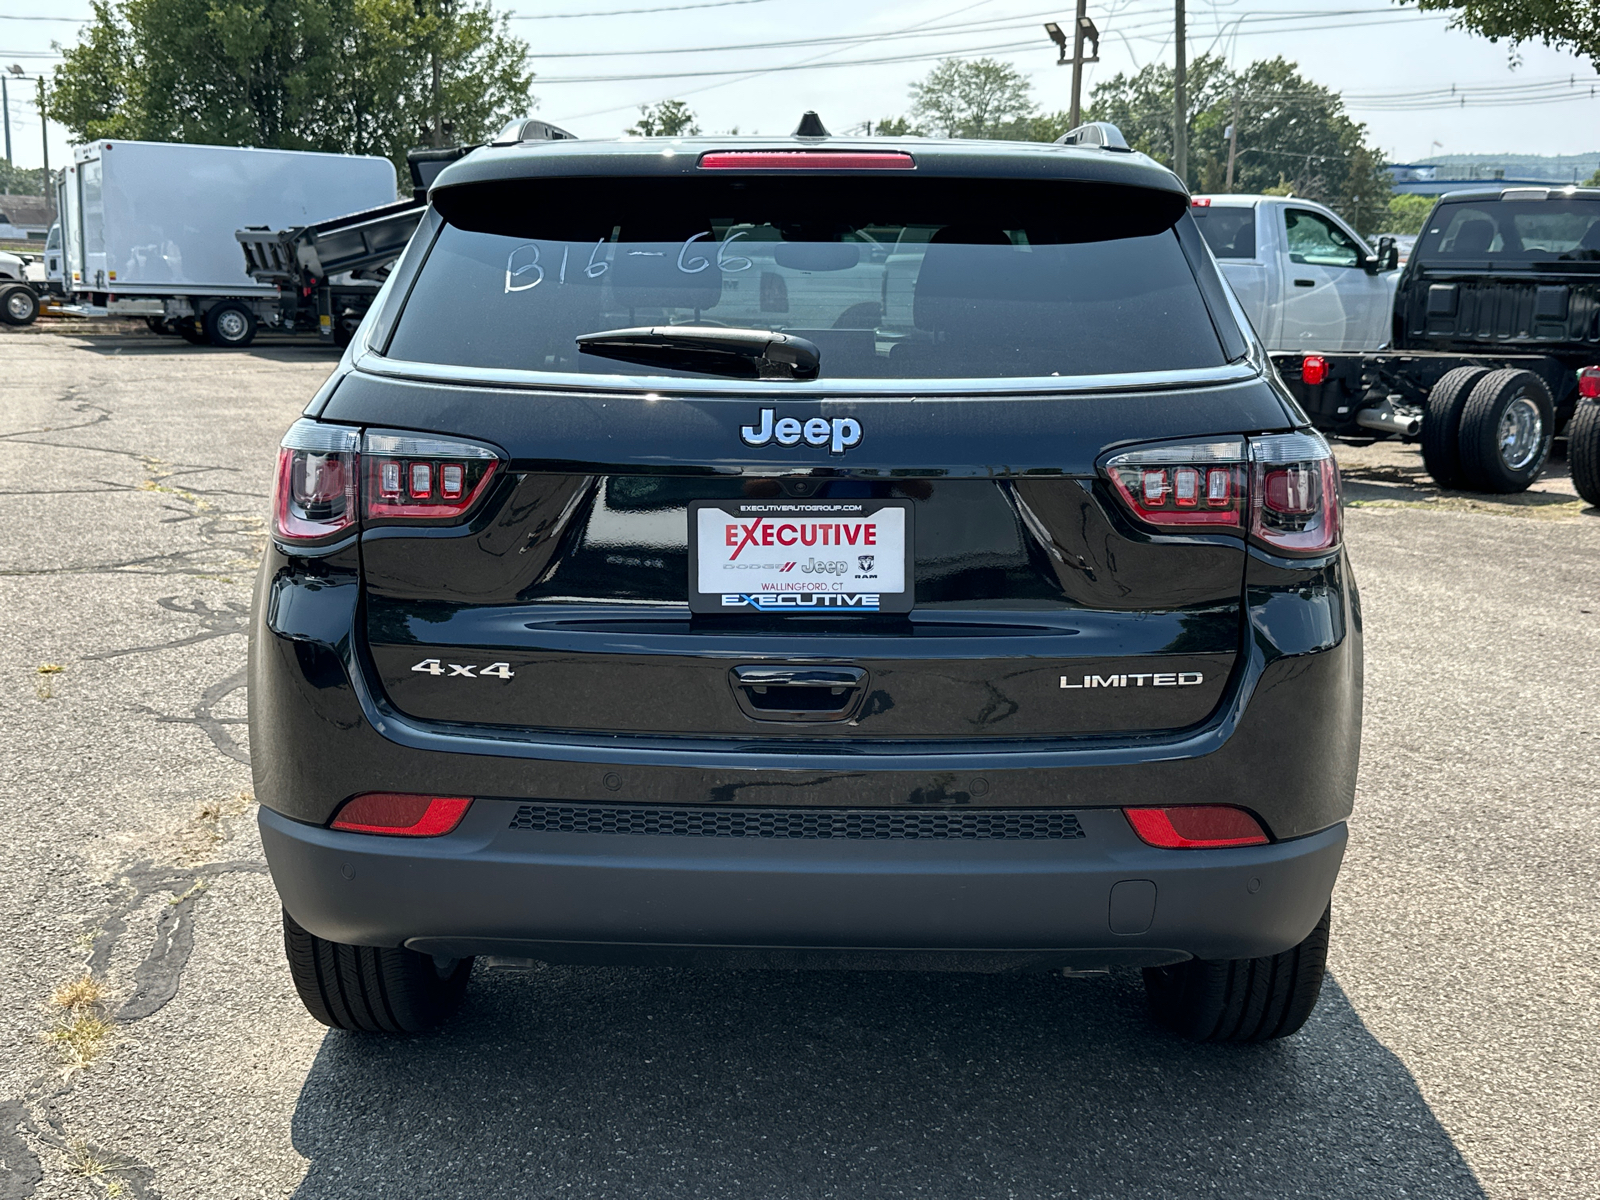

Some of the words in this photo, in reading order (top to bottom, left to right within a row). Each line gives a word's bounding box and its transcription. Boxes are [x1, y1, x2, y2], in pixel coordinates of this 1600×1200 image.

[741, 408, 862, 453] Jeep
[725, 517, 877, 561] EXECUTIVE
[801, 557, 848, 576] Jeep
[761, 582, 830, 591] WALLINGFORD,
[831, 582, 844, 591] CT
[721, 593, 880, 608] EXECUTIVE
[411, 658, 515, 679] 4x4
[1060, 671, 1204, 689] LIMITED
